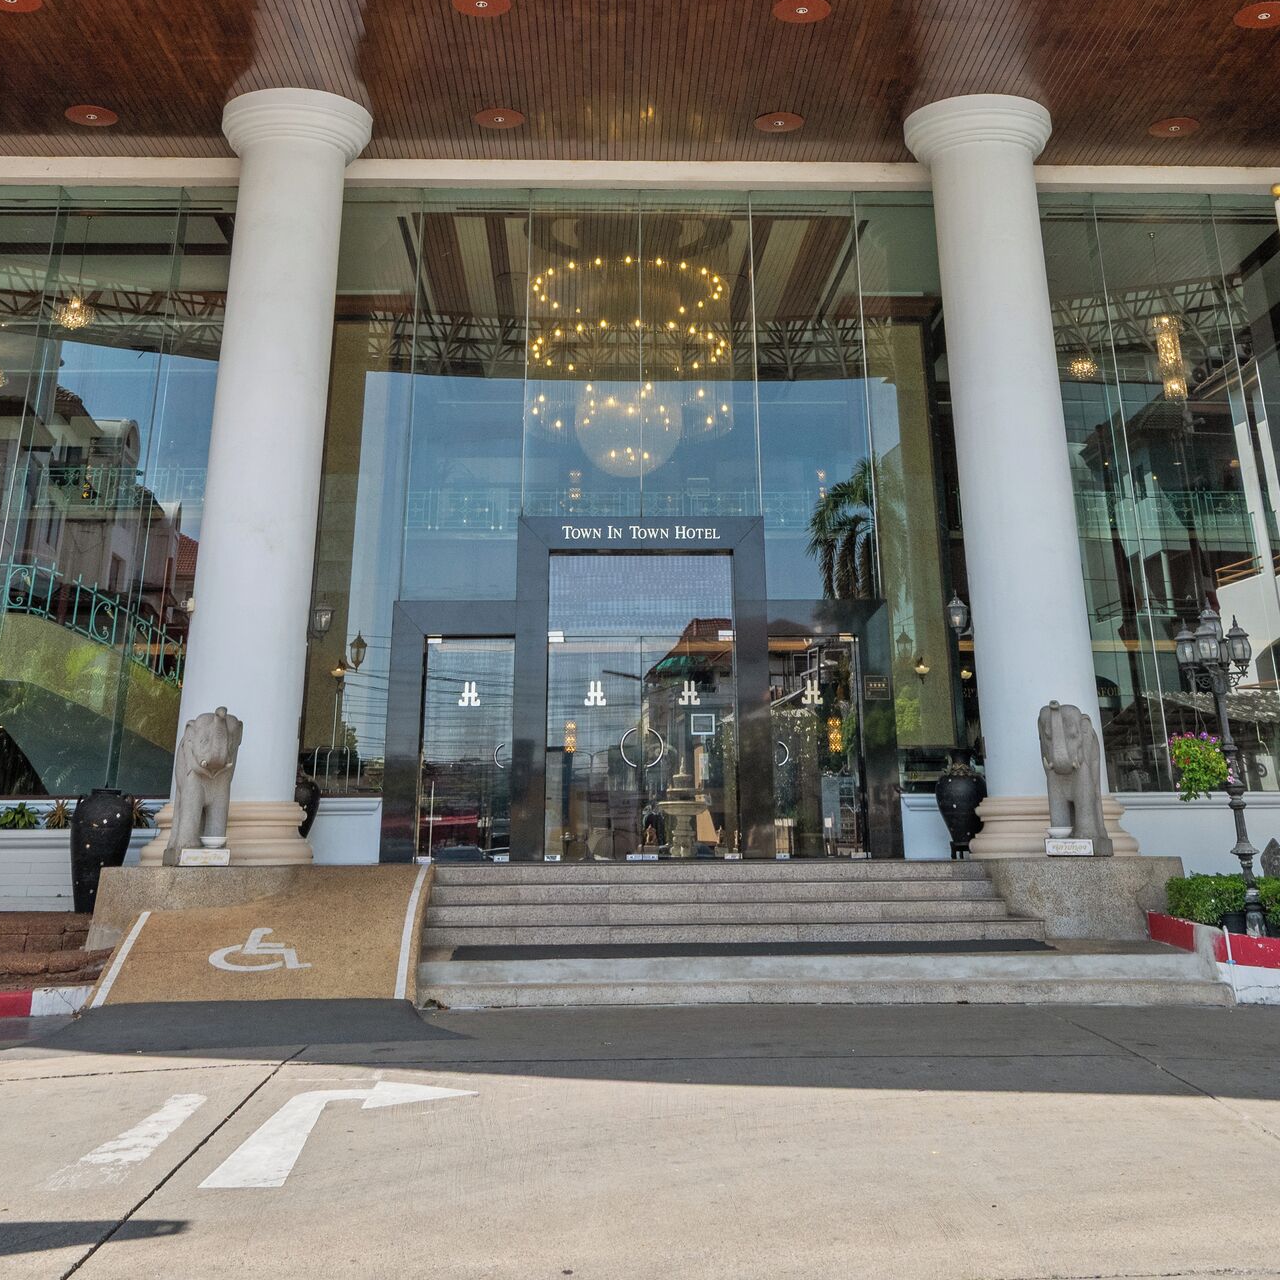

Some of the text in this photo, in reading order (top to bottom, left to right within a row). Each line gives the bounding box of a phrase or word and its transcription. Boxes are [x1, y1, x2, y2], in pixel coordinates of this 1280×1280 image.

[561, 525, 721, 540] TOWN IN TOWN HOTEL
